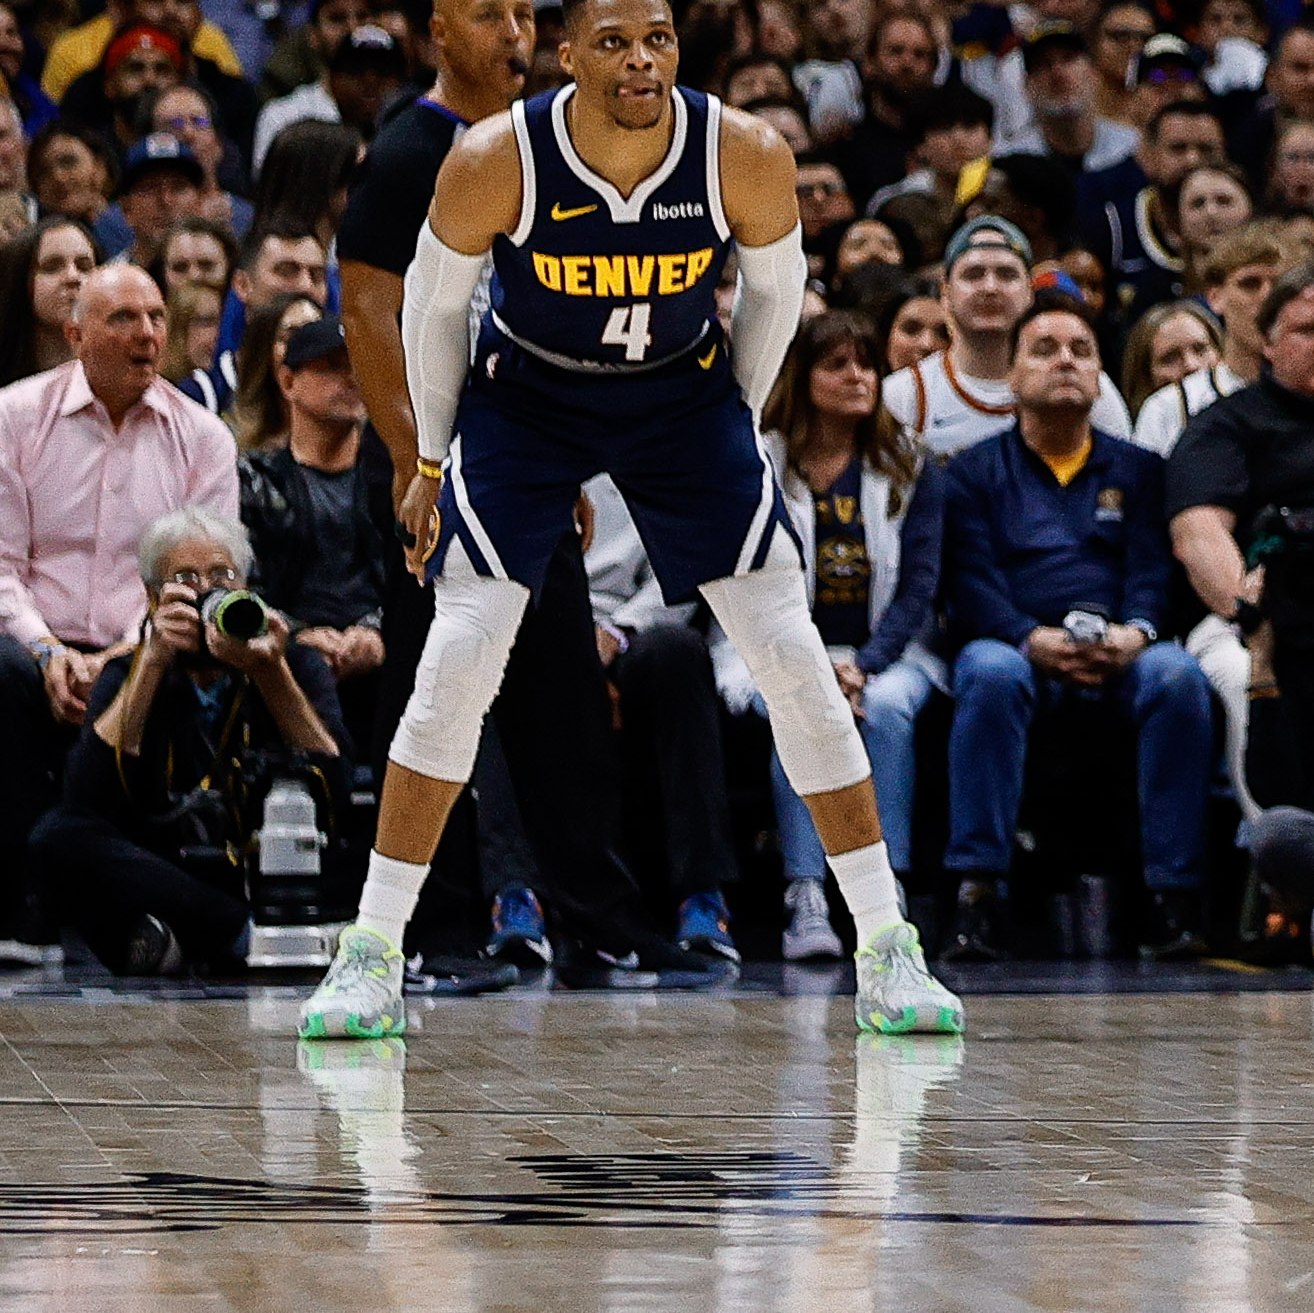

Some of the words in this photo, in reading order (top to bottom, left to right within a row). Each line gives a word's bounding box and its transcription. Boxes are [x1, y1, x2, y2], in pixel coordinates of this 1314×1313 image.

[652, 201, 705, 222] ibotta
[531, 246, 715, 298] DENVER
[600, 301, 653, 363] 4
